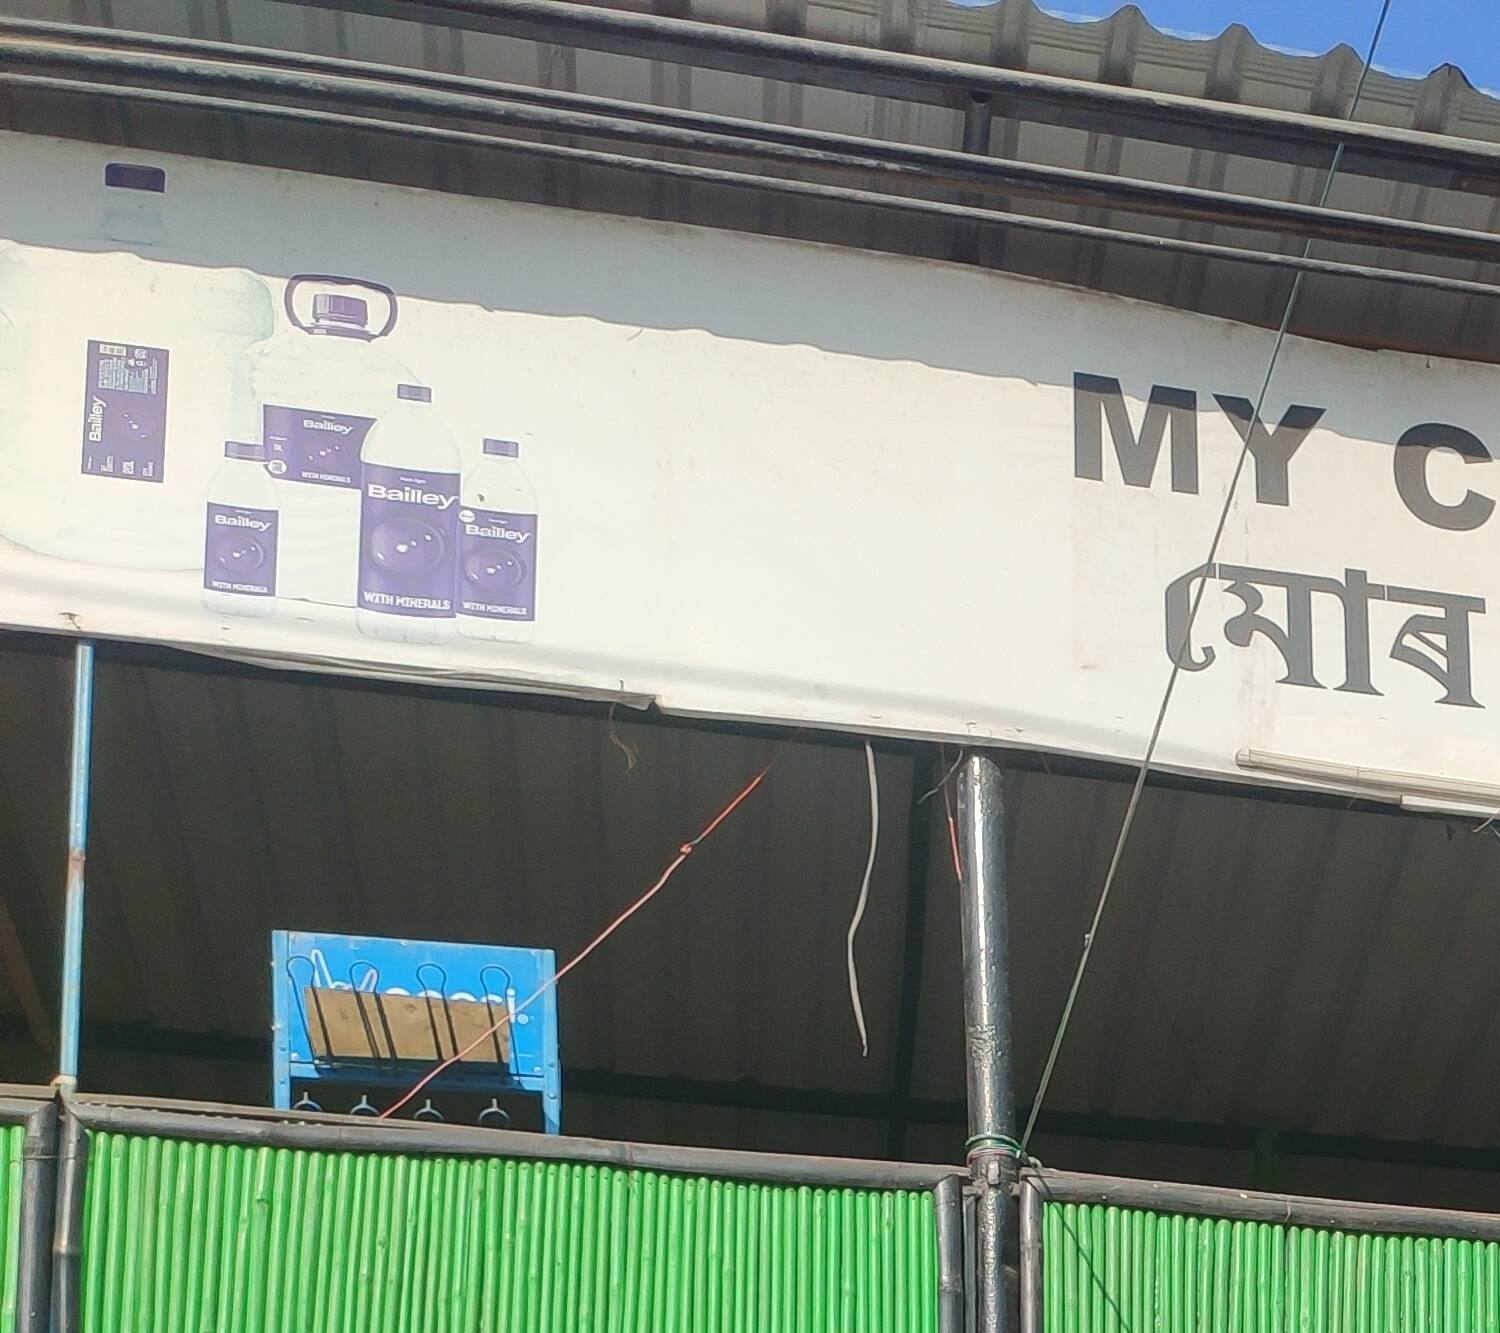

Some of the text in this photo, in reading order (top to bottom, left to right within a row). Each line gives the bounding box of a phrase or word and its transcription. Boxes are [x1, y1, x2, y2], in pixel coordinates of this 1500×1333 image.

[1073, 371, 1327, 507] MY
[367, 483, 459, 510] Bailley
[214, 514, 273, 532] Bailley
[465, 524, 531, 544] Bailley
[363, 591, 451, 610] WITH MINERALS
[1165, 563, 1486, 709] মোৰ
